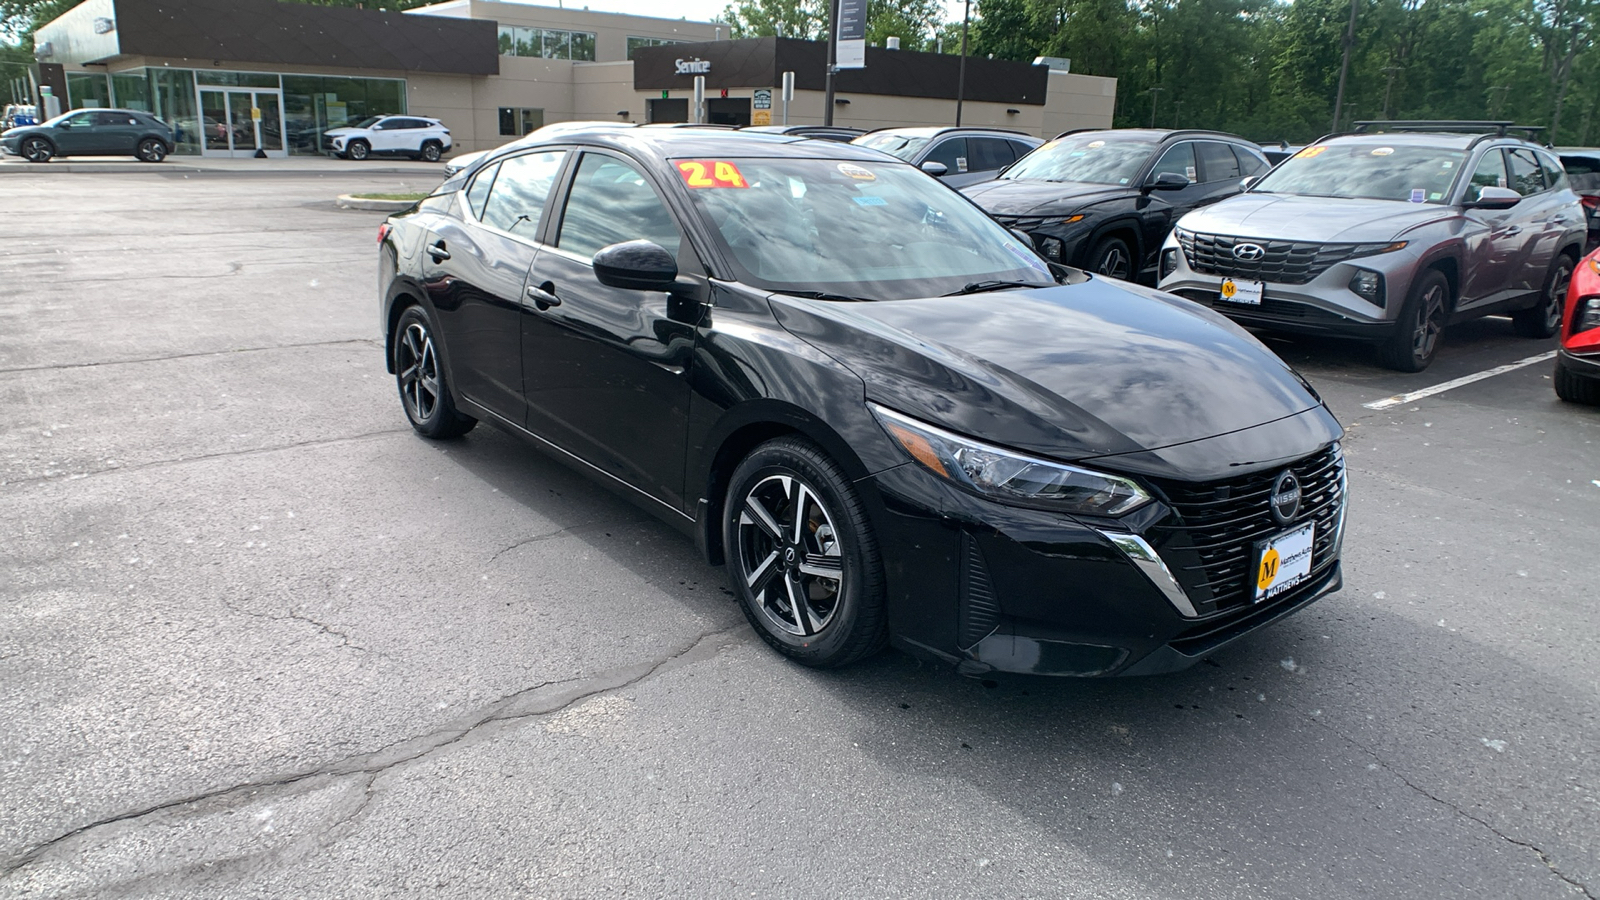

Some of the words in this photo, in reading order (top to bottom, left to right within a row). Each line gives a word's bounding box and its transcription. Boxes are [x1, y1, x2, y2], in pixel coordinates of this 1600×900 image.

[675, 58, 711, 74] Service
[679, 161, 744, 187] 24
[1260, 557, 1278, 583] M
[1267, 575, 1301, 599] MATTHEWS
